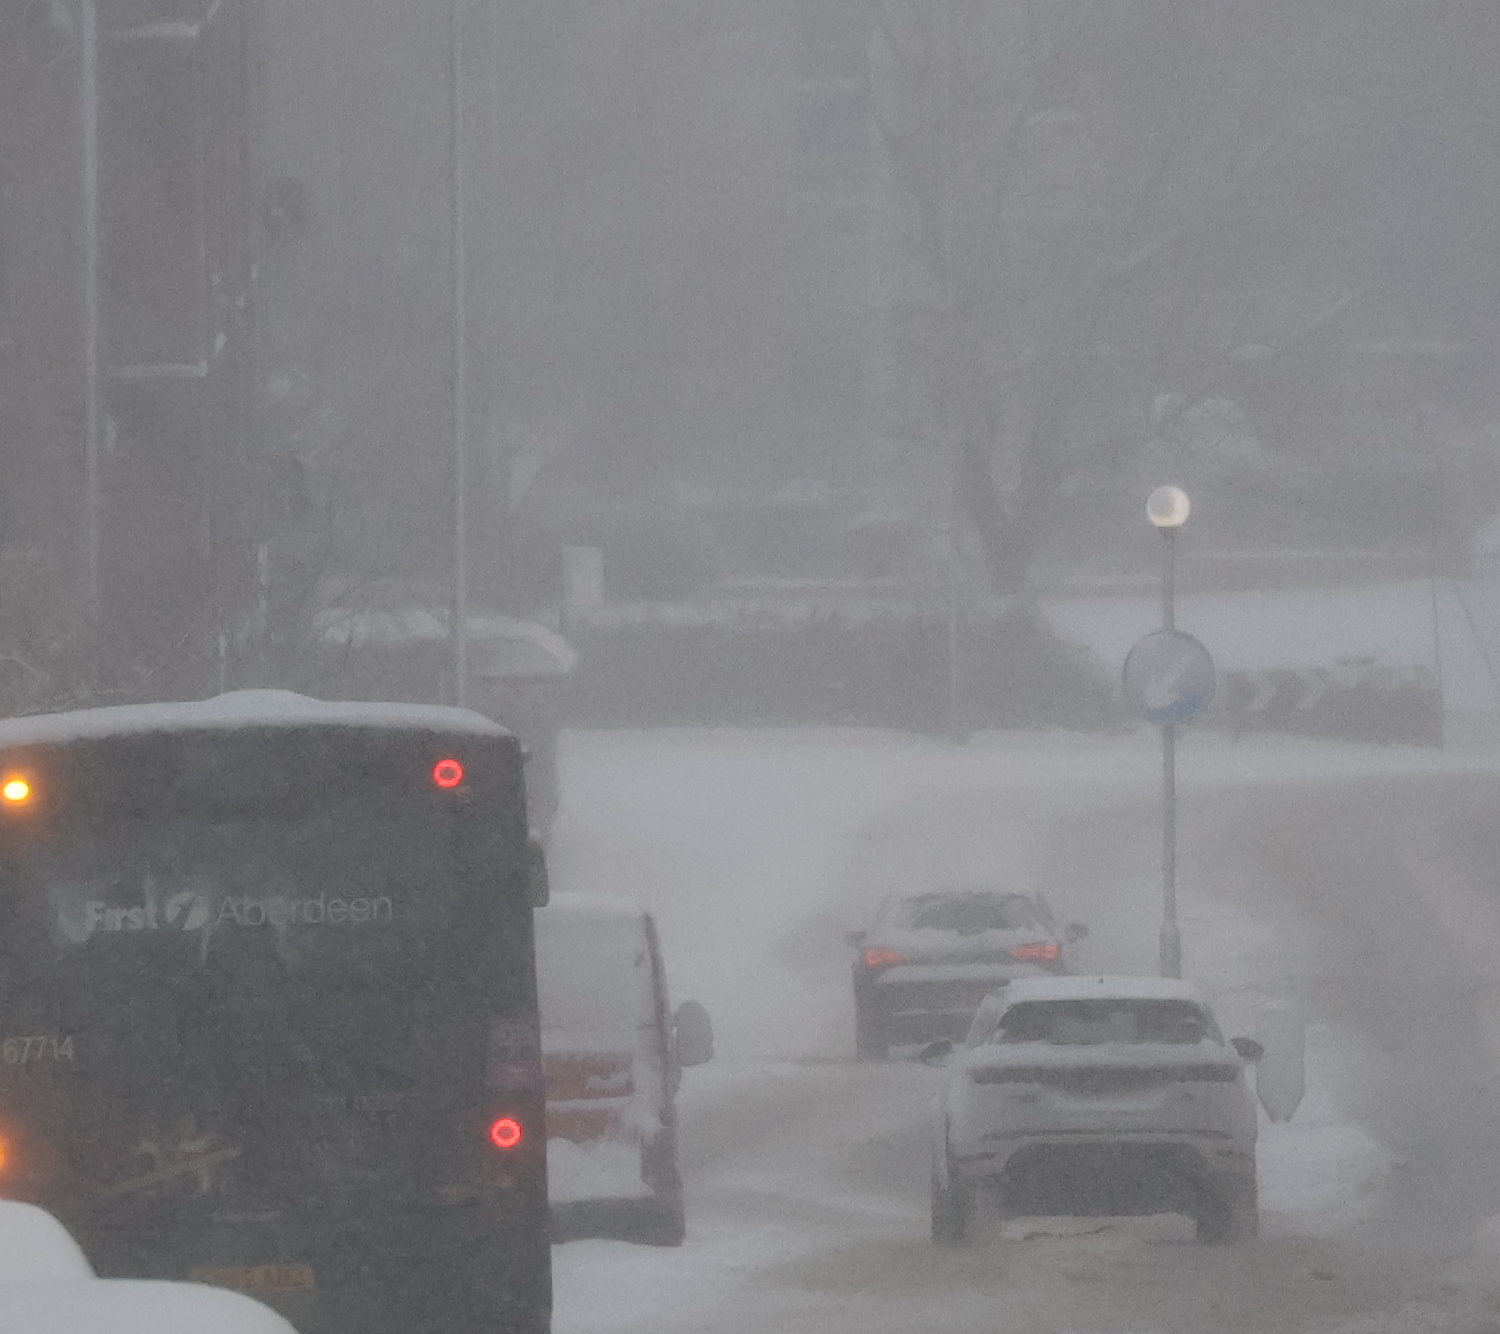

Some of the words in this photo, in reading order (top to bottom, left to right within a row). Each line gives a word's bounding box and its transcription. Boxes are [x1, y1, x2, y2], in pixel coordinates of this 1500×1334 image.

[85, 898, 158, 932] First
[216, 892, 392, 927] Aberdeen
[2, 1035, 74, 1064] 67714
